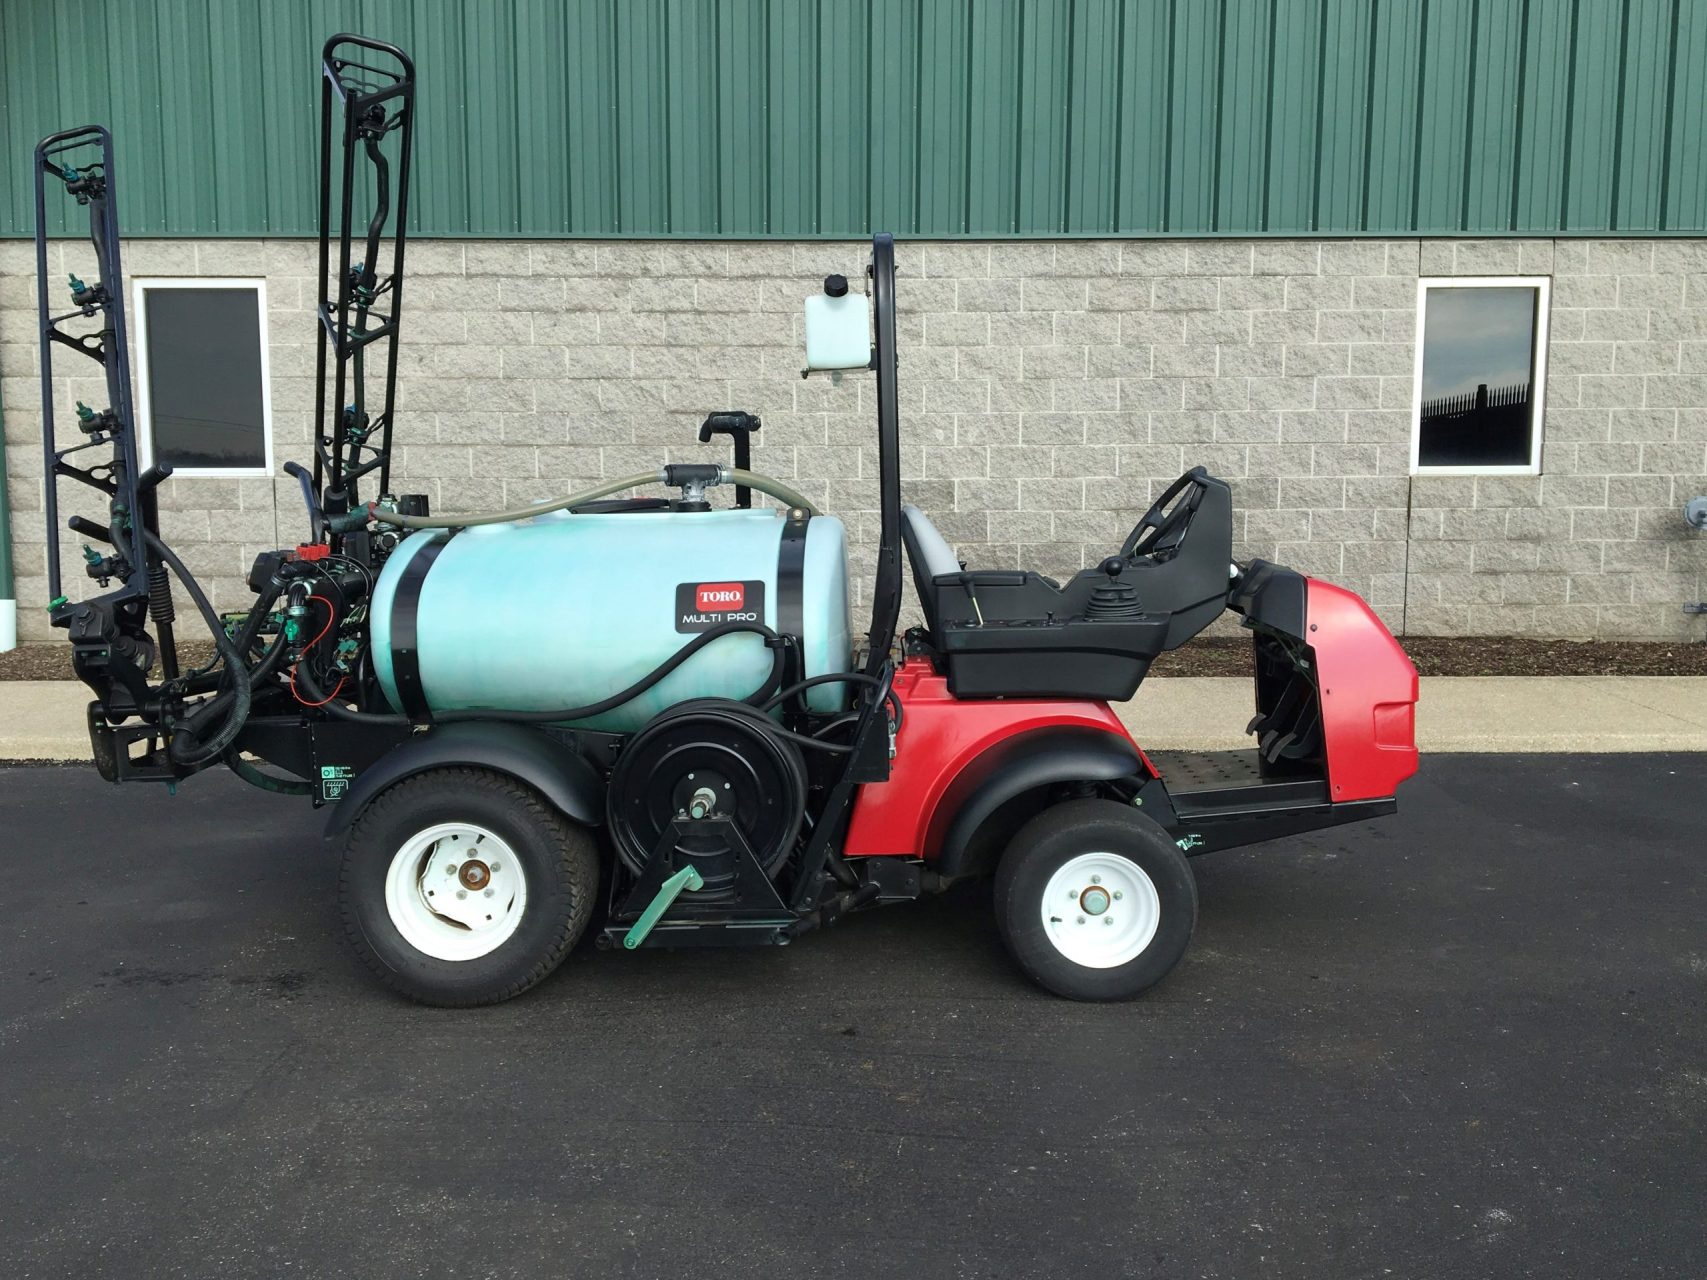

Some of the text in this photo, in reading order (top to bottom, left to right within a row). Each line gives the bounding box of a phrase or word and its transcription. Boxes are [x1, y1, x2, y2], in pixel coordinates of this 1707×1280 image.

[700, 591, 741, 602] TORO
[683, 613, 757, 623] MULTI PRO
